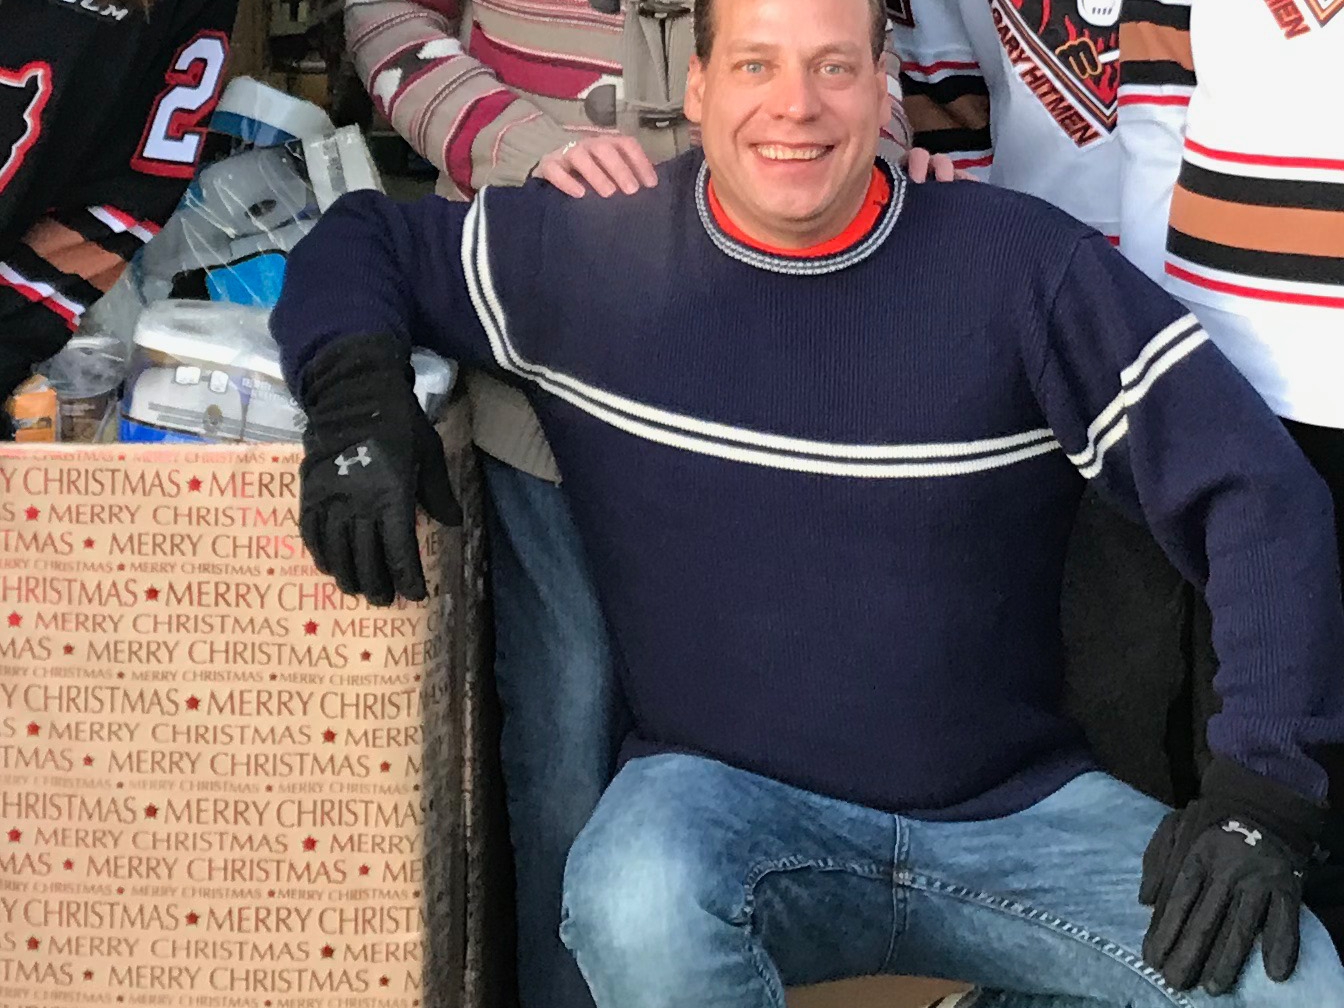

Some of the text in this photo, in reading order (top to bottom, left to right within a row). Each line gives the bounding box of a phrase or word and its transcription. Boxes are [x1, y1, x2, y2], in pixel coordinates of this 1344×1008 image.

[135, 34, 227, 170] 2
[1019, 63, 1102, 149] HITMEN
[22, 466, 181, 498] CHRISTMAS
[209, 471, 298, 499] MERR
[47, 503, 142, 525] MERRY
[152, 504, 300, 529] CHRISTMA
[108, 532, 205, 557] MERRY
[210, 534, 312, 561] CHRIST
[33, 557, 114, 574] CHRISTMAS
[129, 561, 178, 574] MERRY
[180, 562, 261, 577] CHRISTMAS
[279, 564, 319, 578] MERR
[165, 582, 272, 610] MERRY
[34, 611, 125, 635] MERRY
[132, 613, 290, 638] CHRISTMAS
[331, 617, 421, 639] MERRY
[86, 640, 180, 664] MERRY
[187, 640, 349, 669] CHRISTMAS
[33, 665, 113, 680] CHRISTMAS
[131, 669, 178, 682] MERRY
[181, 670, 264, 684] CHRISTMAS
[279, 671, 327, 686] MERRY
[328, 673, 411, 687] CHRISTMAS
[23, 682, 180, 717] CHRISTMAS
[206, 689, 315, 718] MERRY
[319, 690, 422, 720] CHRIST
[47, 720, 141, 743] MERRY
[151, 723, 312, 746] CHRISTMAS
[108, 749, 202, 776] MERRY
[209, 751, 371, 779] CHRISTMAS
[277, 780, 326, 794] MERRY
[164, 798, 272, 827] MERRY
[34, 827, 124, 850] MERRY
[131, 831, 289, 854] CHRISTMAS
[329, 833, 420, 855] MERRY
[86, 854, 179, 881] MERRY
[186, 858, 348, 885] CHRISTMAS
[181, 886, 262, 900] CHRISTMAS
[278, 887, 325, 901] MERRY
[328, 887, 408, 902] CHRISTMAS
[22, 898, 180, 932] CHRISTMAS
[206, 905, 315, 934] MERRY
[318, 906, 424, 936] CHRIST
[47, 935, 140, 958] MERRY
[150, 939, 311, 963] CHRISTMAS
[108, 965, 202, 991] MERRY
[208, 967, 370, 994] CHRISTMAS
